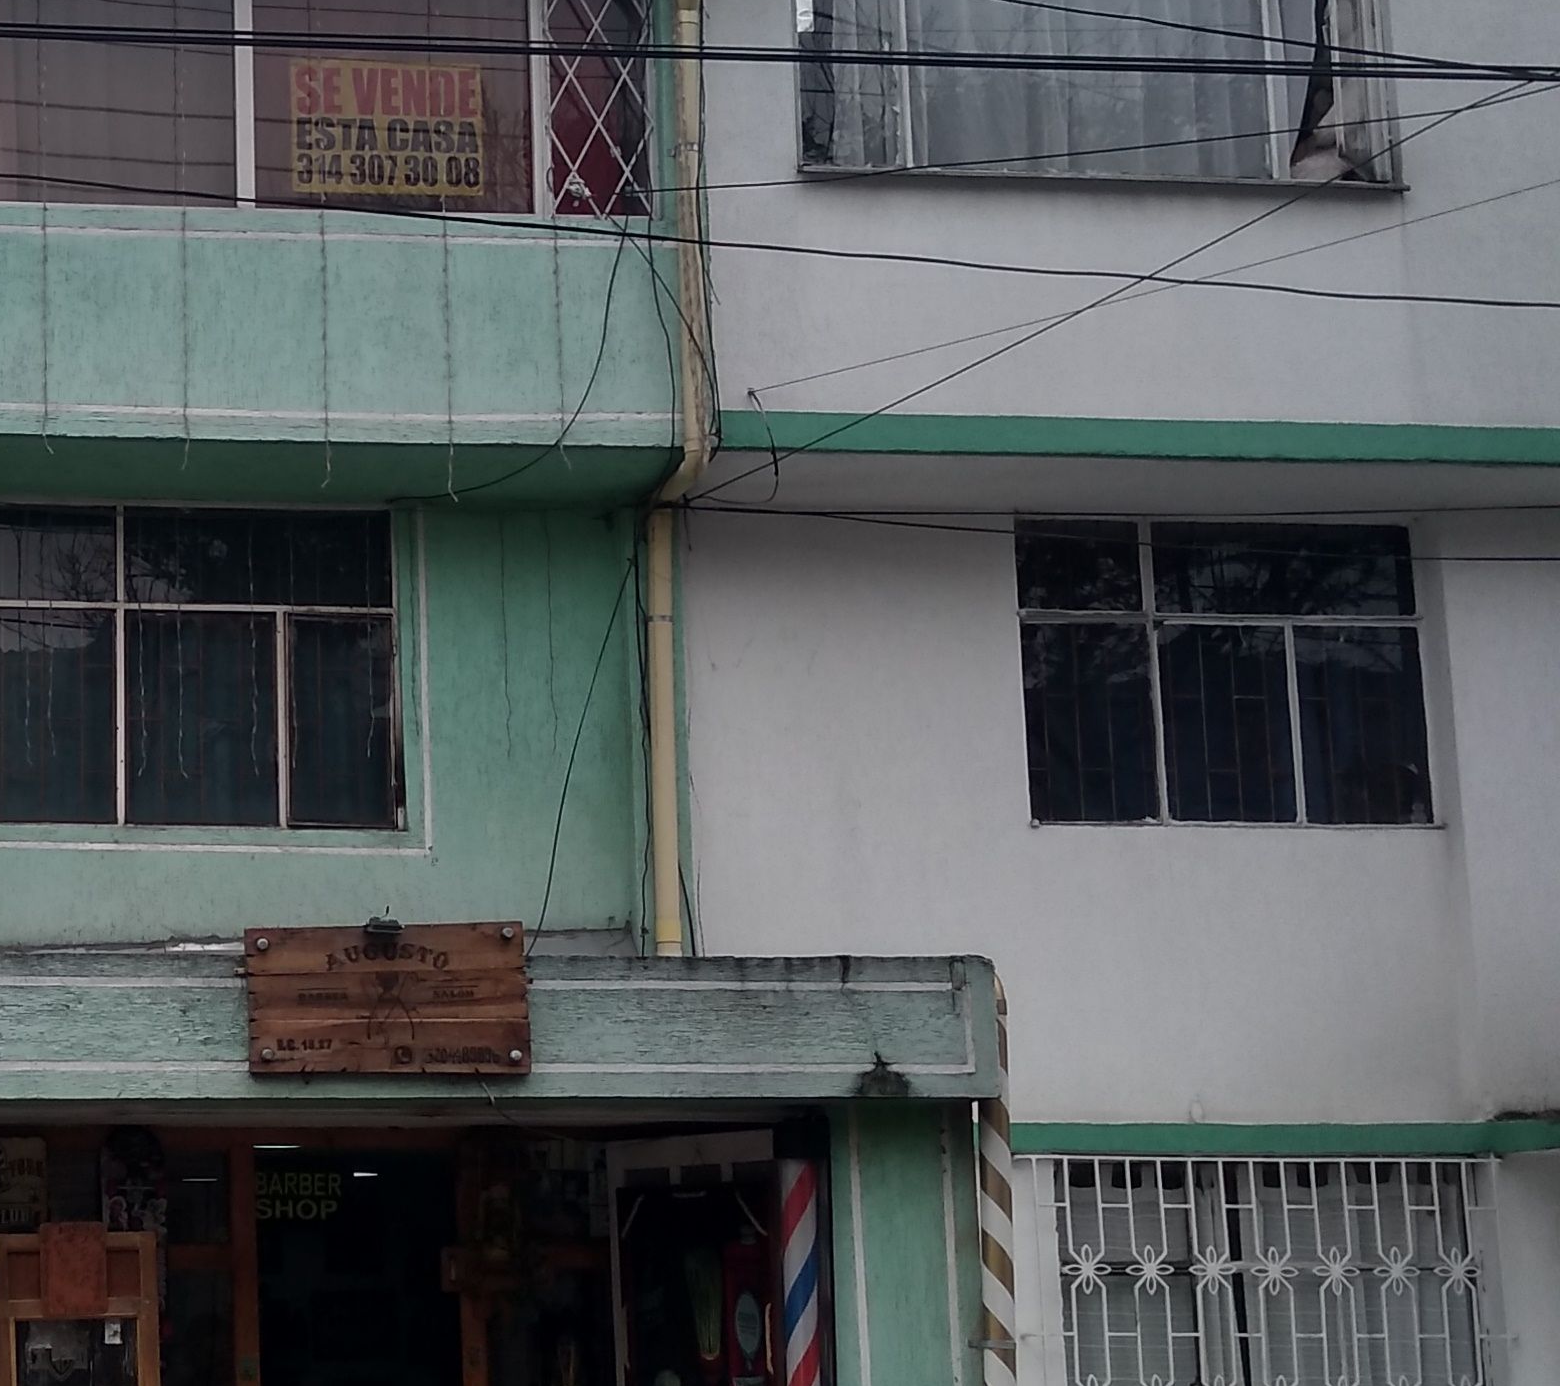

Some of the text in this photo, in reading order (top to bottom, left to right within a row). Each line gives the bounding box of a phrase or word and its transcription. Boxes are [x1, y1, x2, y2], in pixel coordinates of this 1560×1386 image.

[294, 66, 479, 118] SE VENDE
[296, 117, 479, 153] ESTA CASA
[296, 153, 480, 188] 314 307 30 08
[325, 941, 449, 971] AUGUSTO
[255, 1172, 342, 1197] BARBER
[255, 1198, 339, 1220] SHOP
